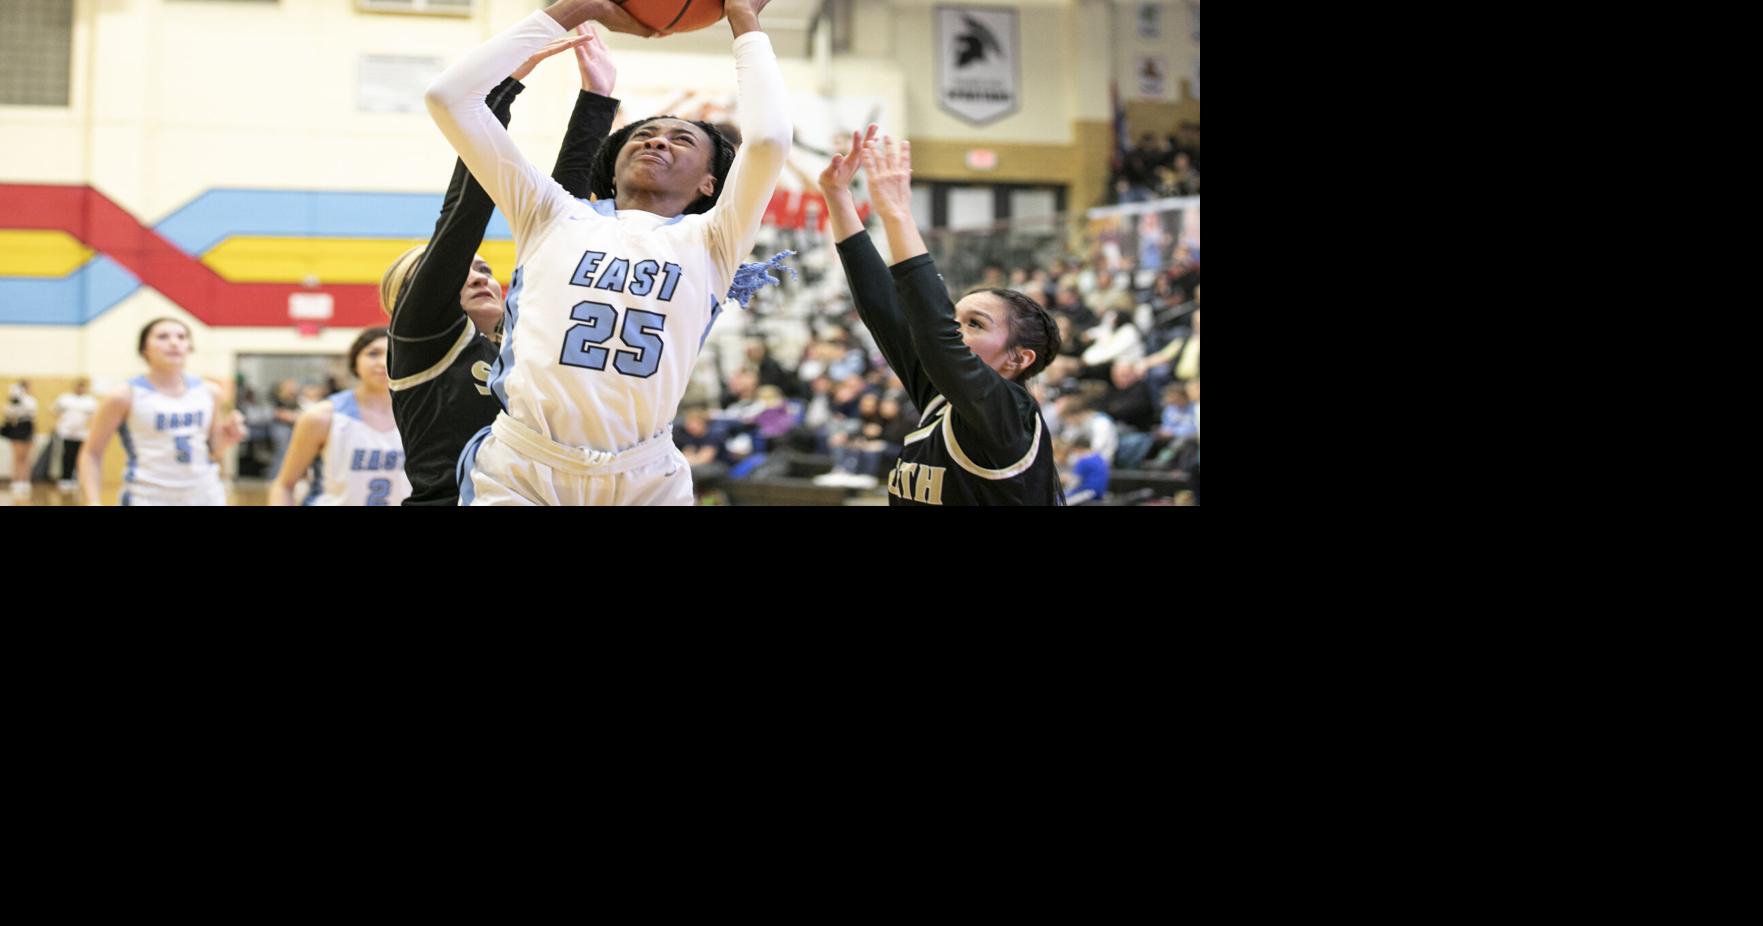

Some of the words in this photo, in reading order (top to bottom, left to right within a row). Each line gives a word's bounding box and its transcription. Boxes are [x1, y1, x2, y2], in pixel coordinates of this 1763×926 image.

[569, 250, 682, 302] EAST
[559, 300, 666, 379] 25
[175, 435, 193, 464] 5
[366, 478, 391, 506] 2
